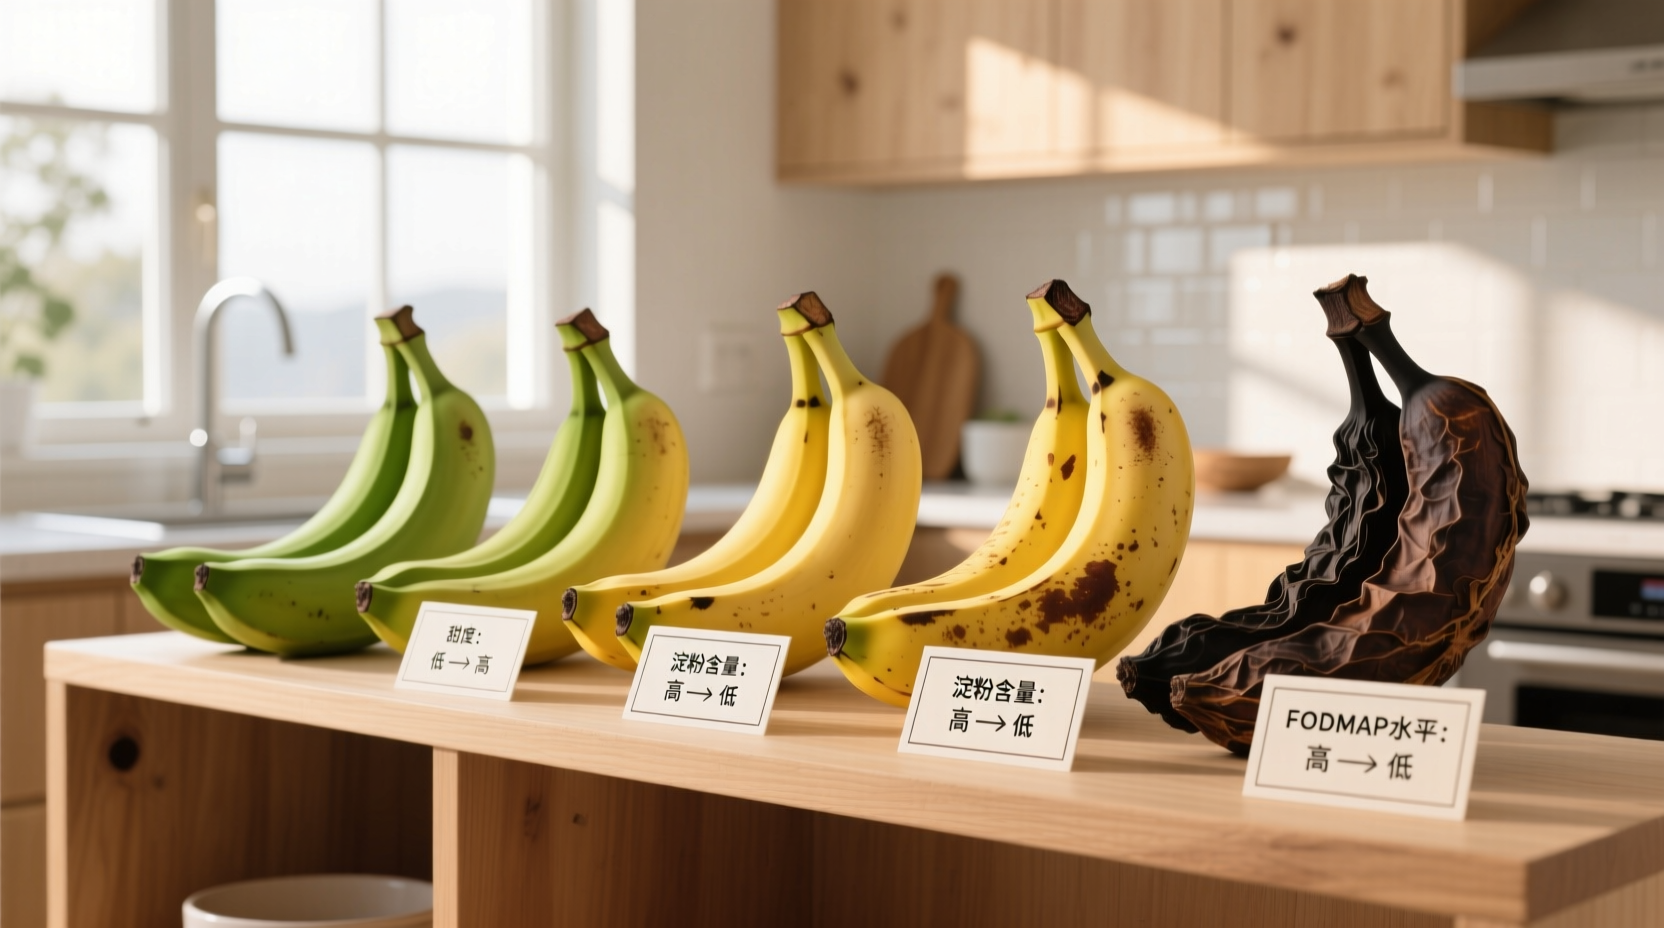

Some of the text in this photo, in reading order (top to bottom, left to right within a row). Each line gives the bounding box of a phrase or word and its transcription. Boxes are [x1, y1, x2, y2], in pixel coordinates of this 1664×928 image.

[474, 654, 493, 675] 高
[664, 679, 739, 707] 高 低
[952, 675, 1045, 704] 淀粉含量：
[948, 706, 1035, 738] 高 低
[1285, 709, 1448, 743] FODMAP水平：
[1305, 744, 1414, 781] 高 低
